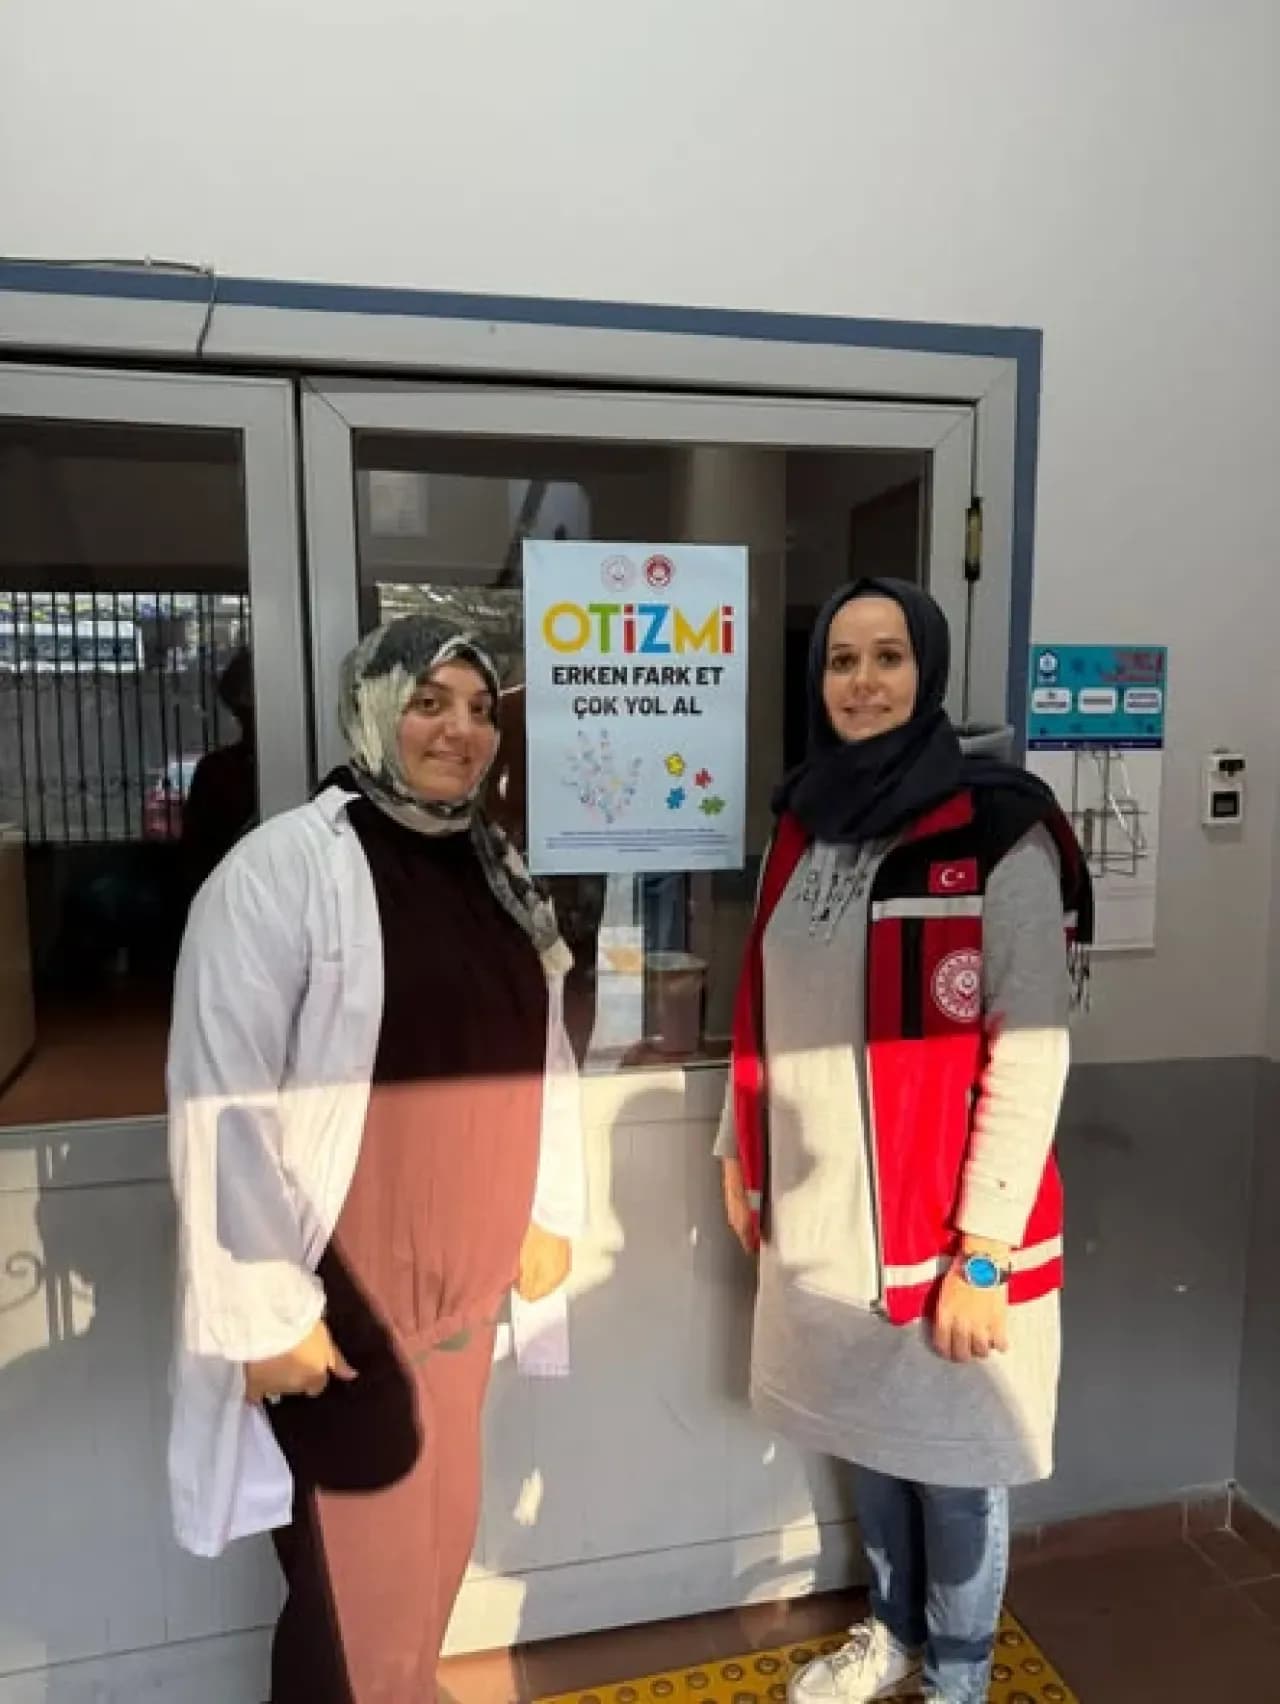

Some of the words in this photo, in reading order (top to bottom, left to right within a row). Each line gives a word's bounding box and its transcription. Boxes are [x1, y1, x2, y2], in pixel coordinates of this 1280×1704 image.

[552, 666, 627, 685] ERKEN
[632, 666, 690, 685] FARK
[696, 666, 724, 685] ET
[574, 696, 618, 719] ÇOK
[624, 696, 667, 716] YOL
[672, 696, 703, 716] AL
